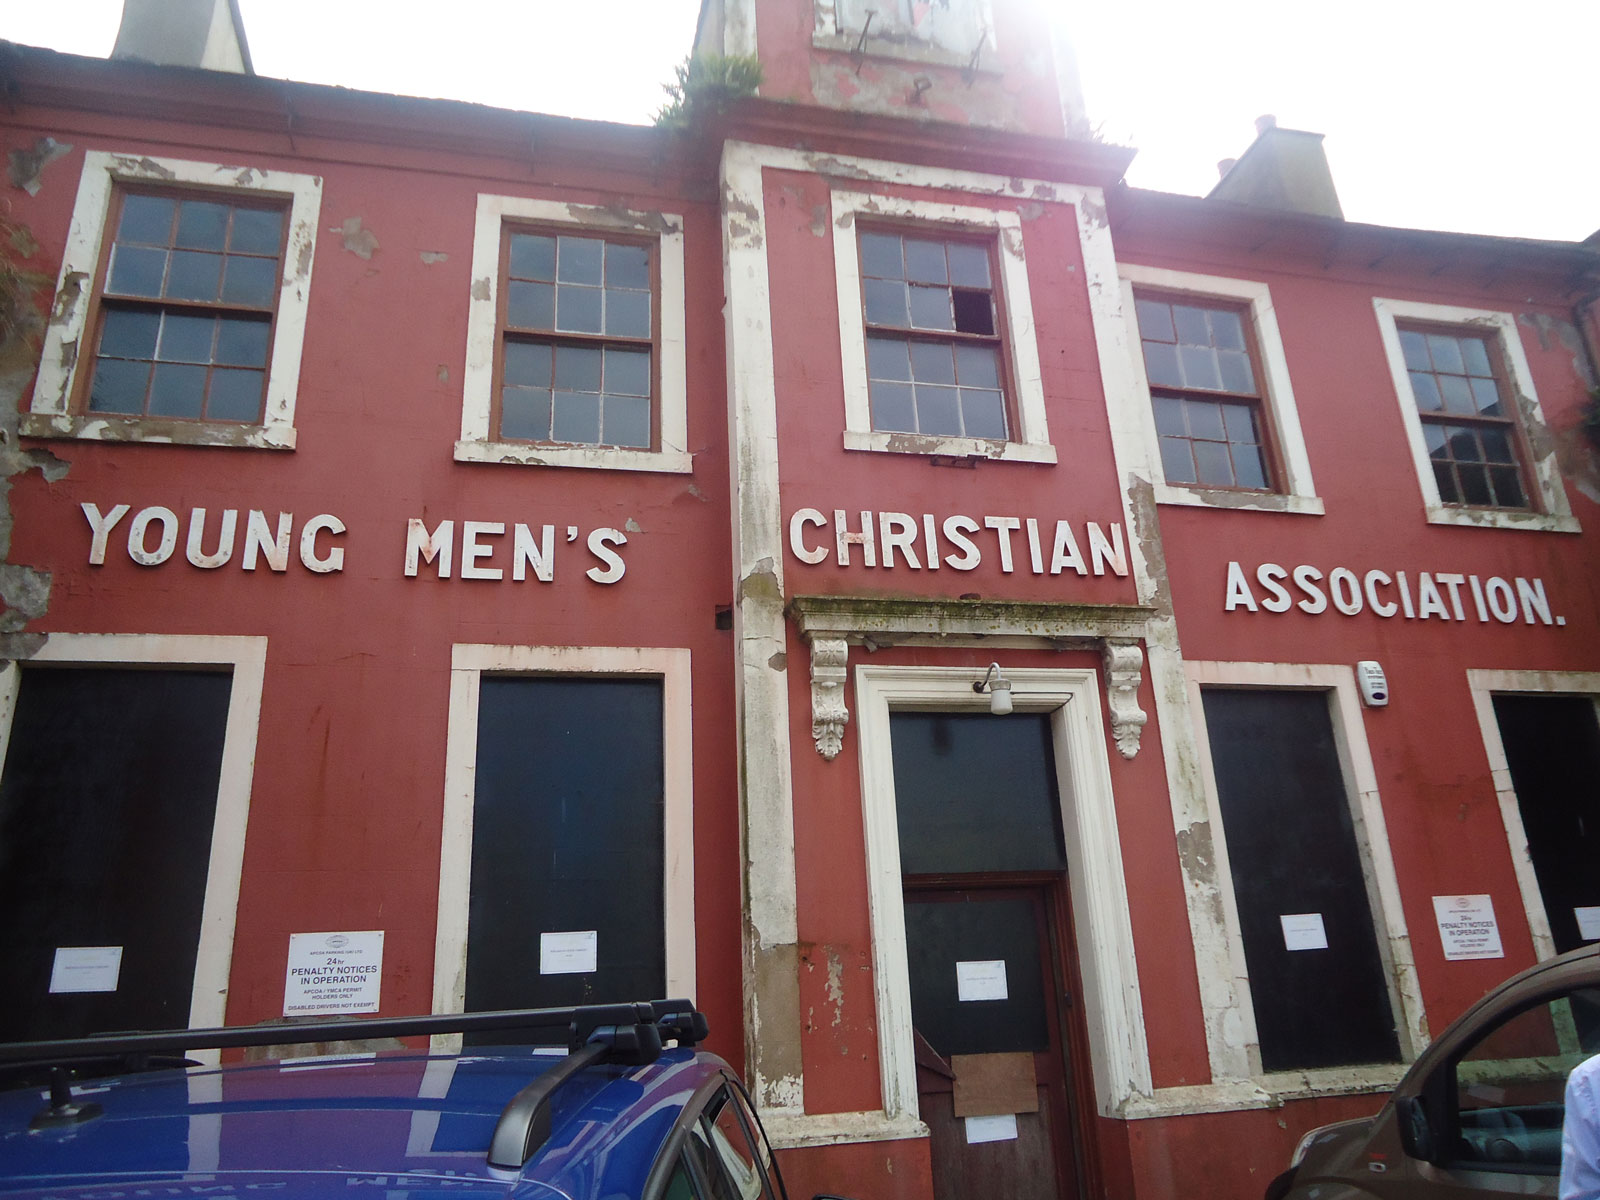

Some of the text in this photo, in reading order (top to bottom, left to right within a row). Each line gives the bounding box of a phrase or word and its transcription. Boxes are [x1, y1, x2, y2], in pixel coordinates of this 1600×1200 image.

[80, 502, 628, 585] YOUNG MEN'S
[789, 508, 1129, 577] CHRISTIAN
[291, 965, 378, 976] PENALTY NOTICES
[300, 975, 367, 984] IN OPERATION
